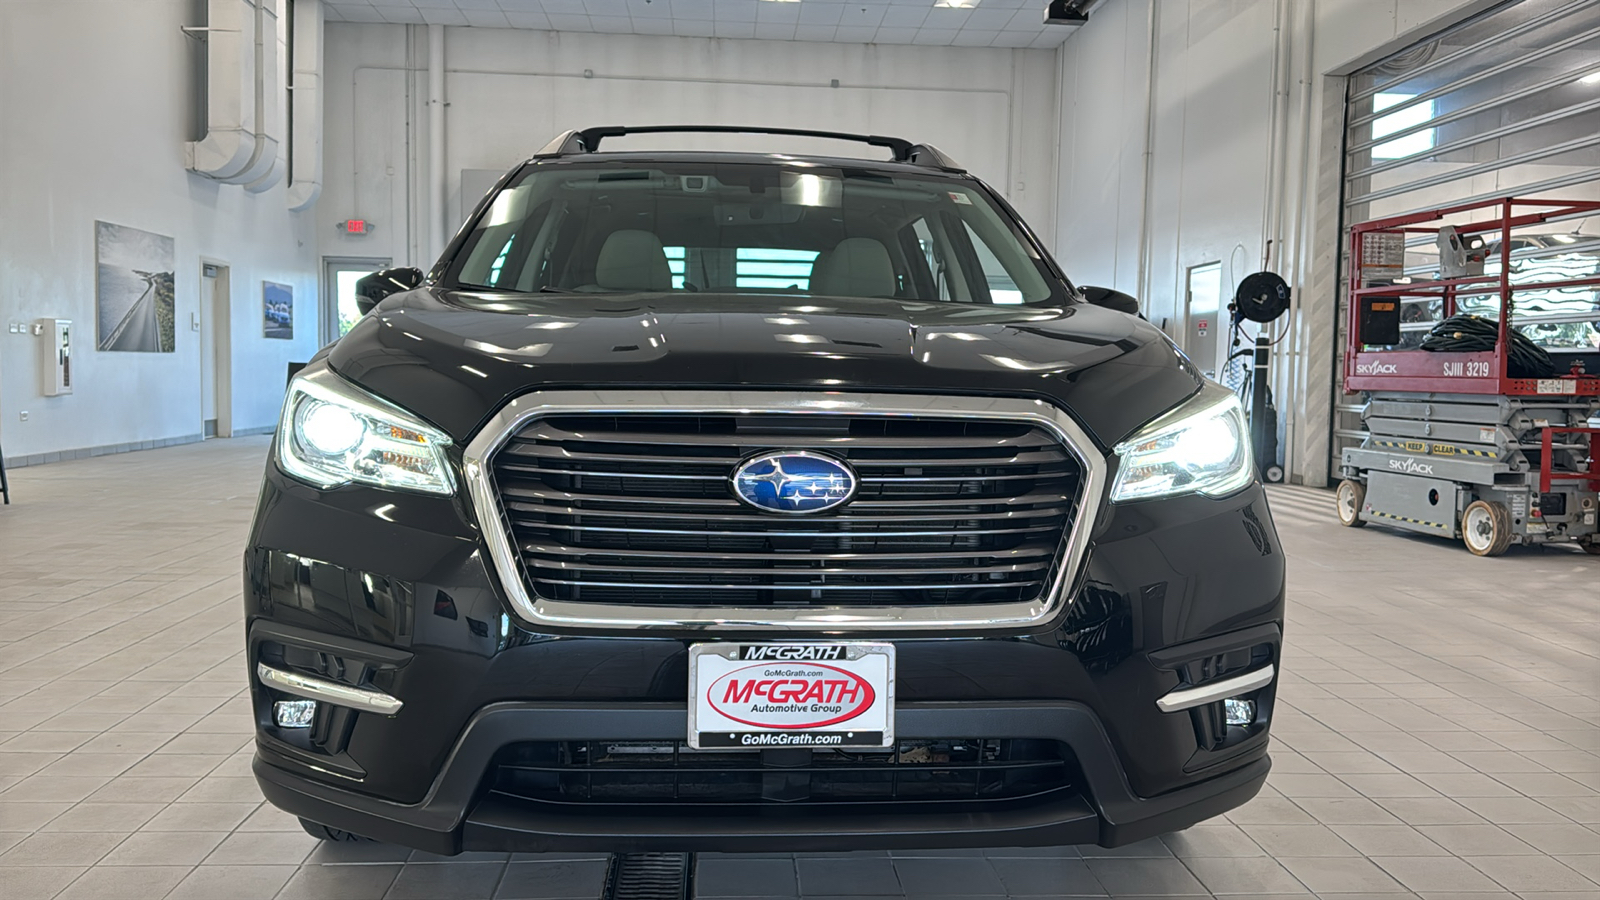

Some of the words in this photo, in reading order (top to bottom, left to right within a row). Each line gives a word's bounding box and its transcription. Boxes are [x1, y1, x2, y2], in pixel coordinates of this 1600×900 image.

[1356, 360, 1397, 375] SKYJACK
[1466, 362, 1489, 377] 3219
[1407, 442, 1423, 450] KEEP
[1433, 444, 1454, 454] CLEAR
[1389, 457, 1433, 475] SKYJACK
[744, 646, 841, 660] McGRATH
[763, 669, 823, 678] GoMcGrath.com
[722, 679, 862, 704] McGRATH
[750, 703, 808, 713] Automotive
[810, 703, 842, 714] Group
[741, 733, 842, 745] GoMcGrath.com
